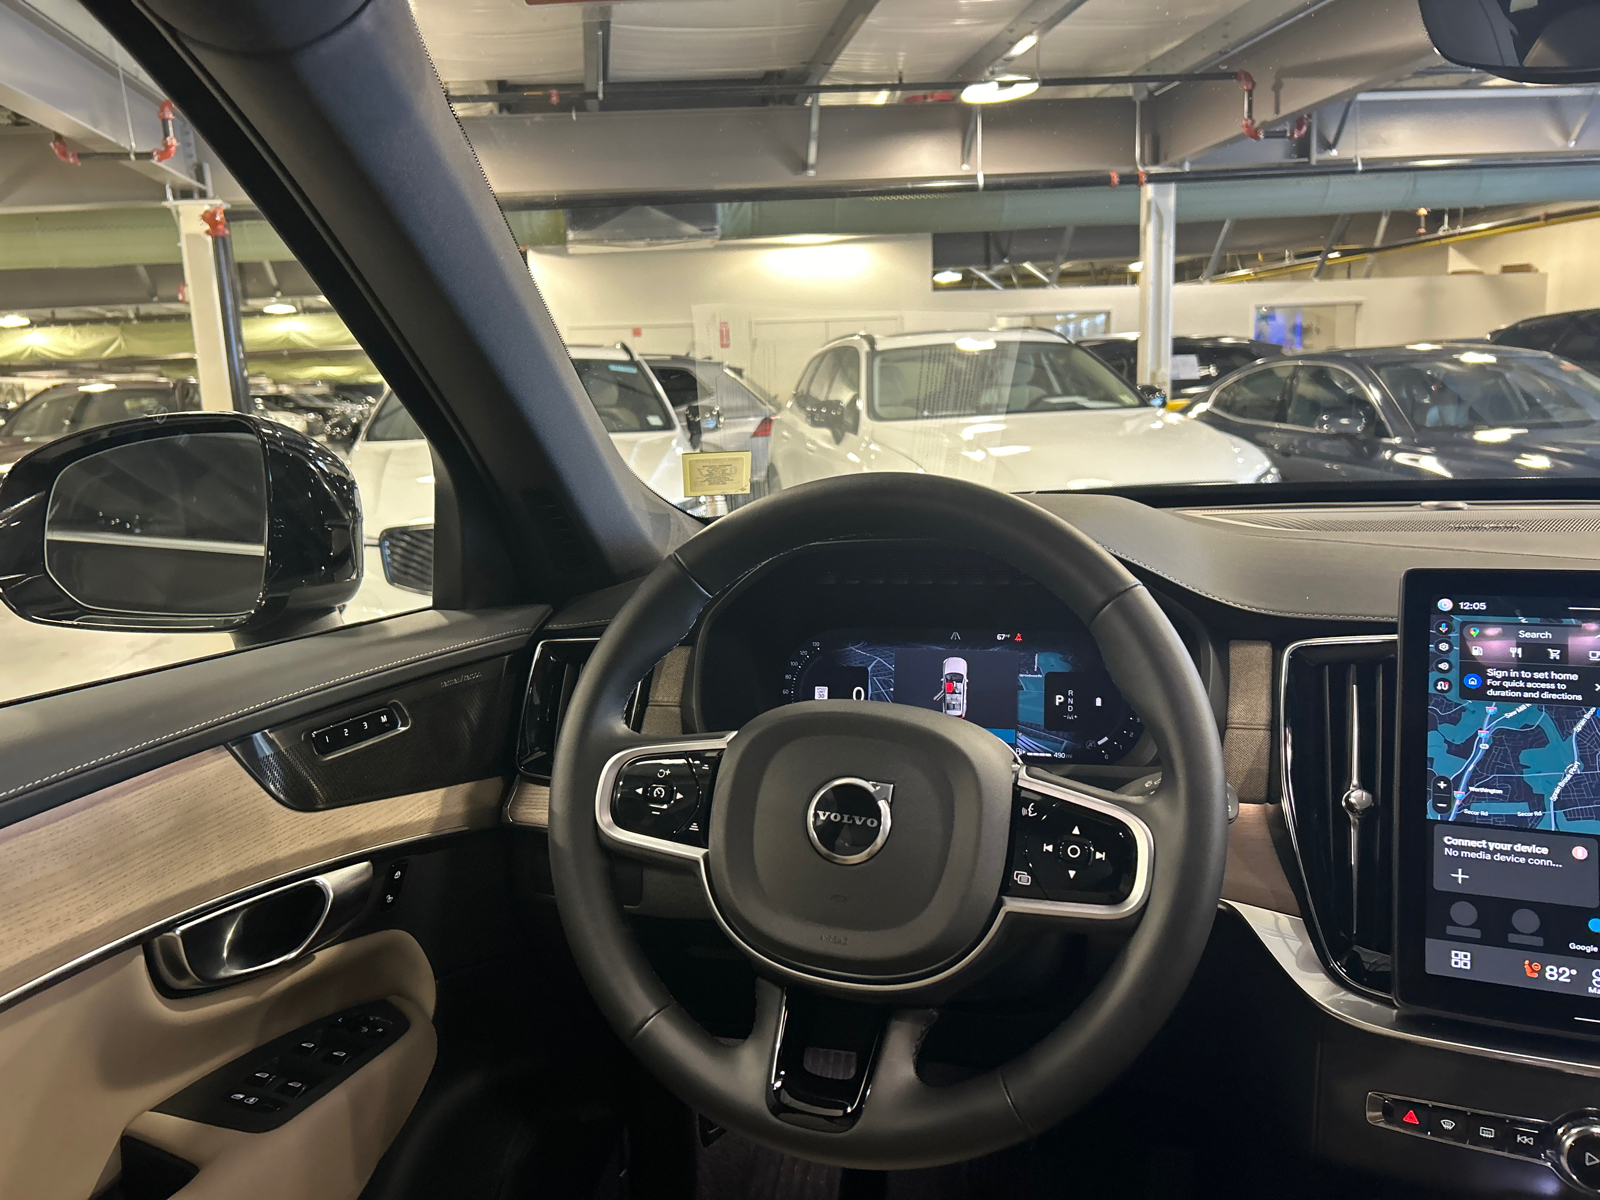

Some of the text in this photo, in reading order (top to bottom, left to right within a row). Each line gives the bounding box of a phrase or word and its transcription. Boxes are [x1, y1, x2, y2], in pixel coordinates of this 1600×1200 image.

[1459, 602, 1487, 610] 12:05
[1518, 630, 1552, 639] Search
[1486, 668, 1579, 681] Sign in to set home
[1486, 679, 1567, 690] For quick access to
[852, 686, 865, 701] 0
[1486, 688, 1583, 701] duration and directions
[1055, 694, 1065, 706] P
[380, 714, 388, 723] M
[1468, 786, 1504, 795] Worthington
[1463, 808, 1479, 816] Secor
[816, 810, 879, 828] VOLVO
[1443, 835, 1549, 855] Connect your device
[1444, 847, 1563, 868] No media device conn...
[1568, 942, 1599, 953] Google
